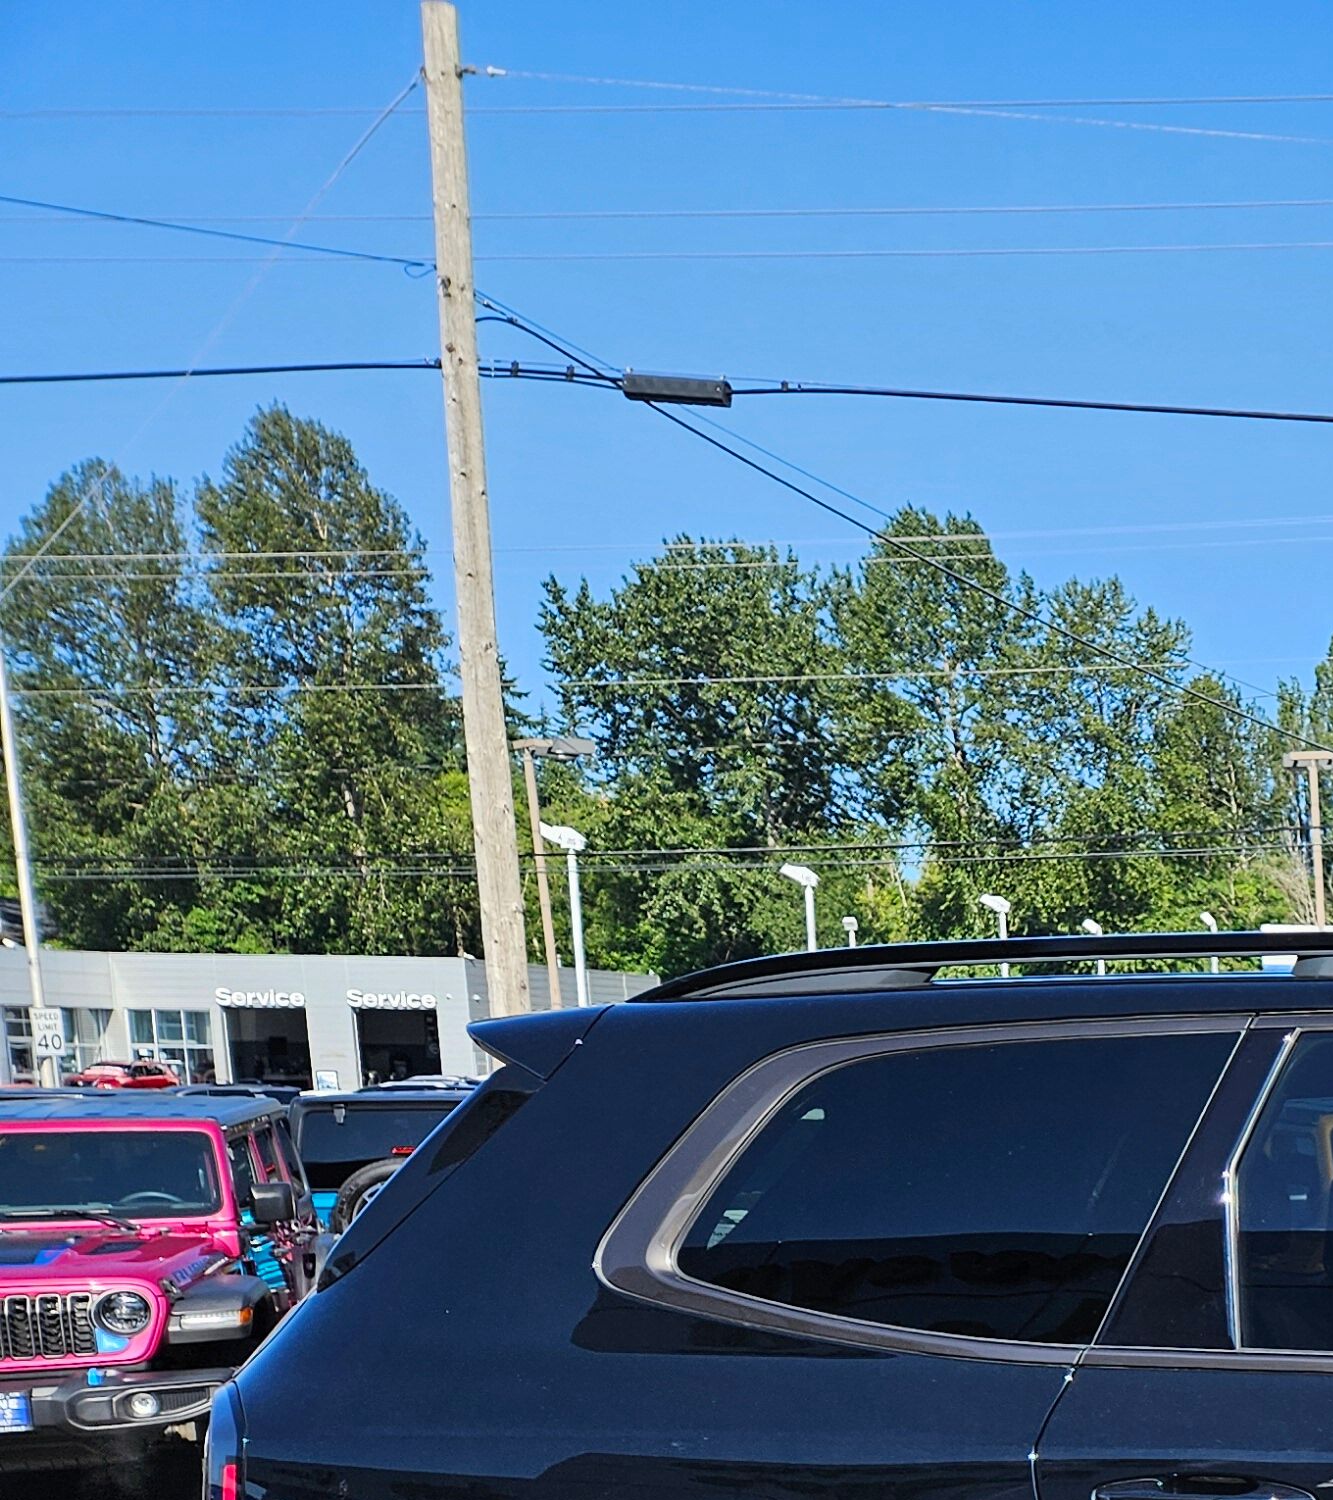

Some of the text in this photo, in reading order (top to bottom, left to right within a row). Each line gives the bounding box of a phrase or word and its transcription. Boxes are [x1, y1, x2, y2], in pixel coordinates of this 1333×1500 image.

[215, 987, 305, 1007] Service
[346, 989, 437, 1009] Service
[34, 1012, 59, 1021] SPEED
[38, 1023, 57, 1032] LIMIT
[38, 1034, 62, 1050] 40
